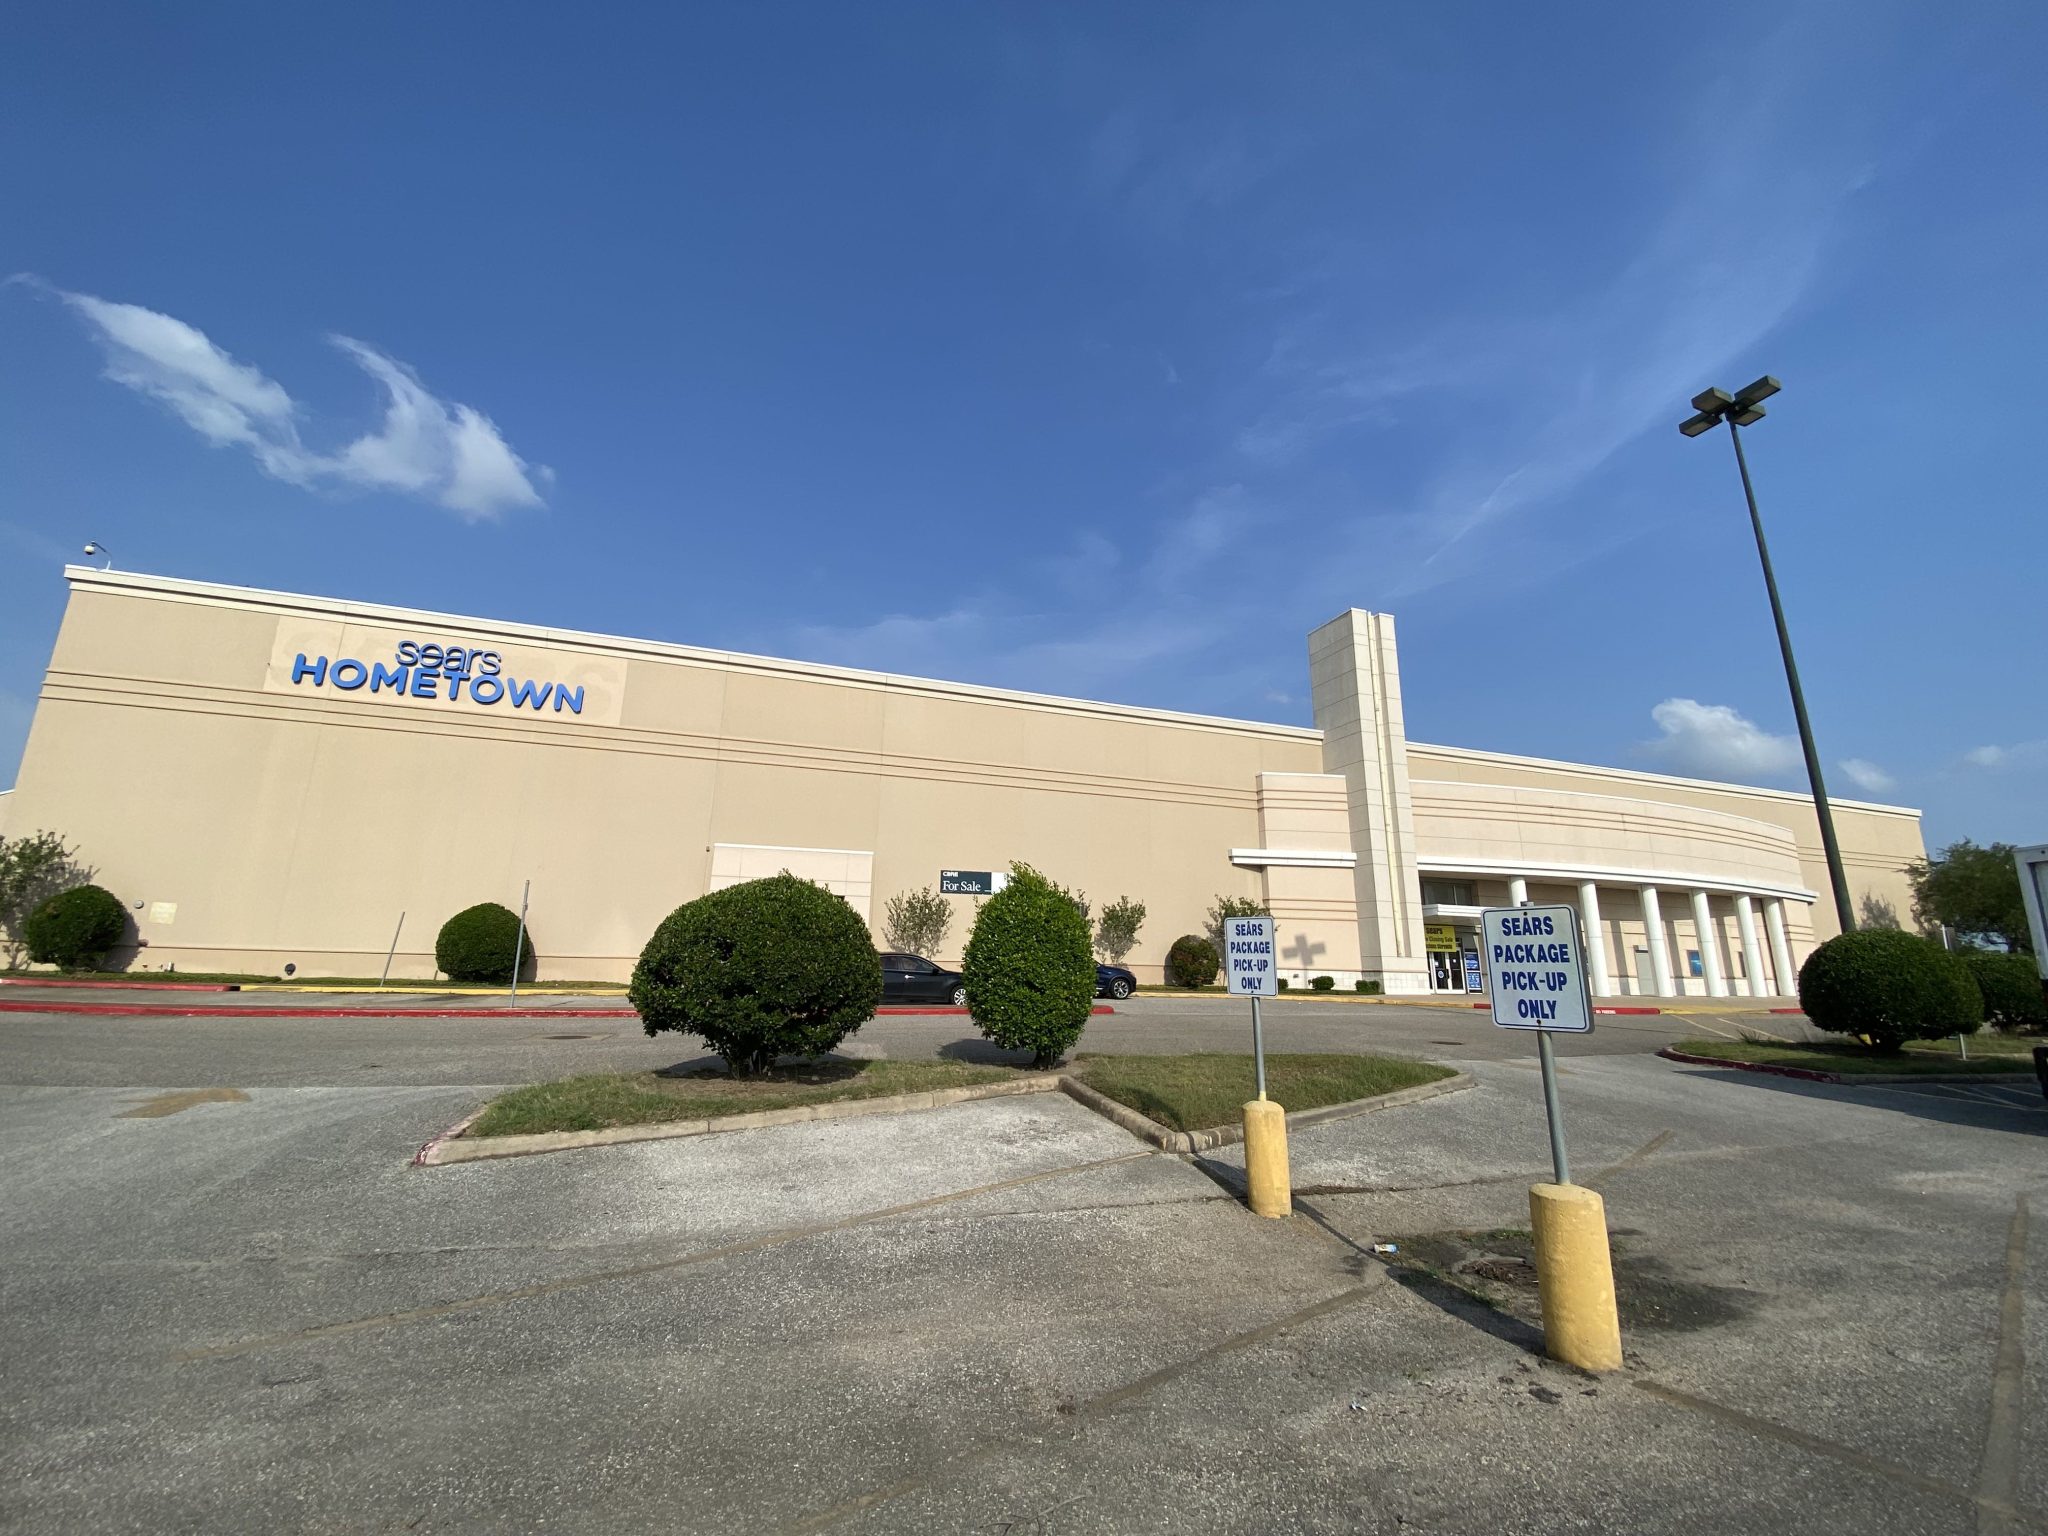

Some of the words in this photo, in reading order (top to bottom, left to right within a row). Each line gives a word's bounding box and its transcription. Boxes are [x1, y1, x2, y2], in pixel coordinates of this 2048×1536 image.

[291, 653, 585, 713] HOMETOWN
[943, 880, 959, 891] For
[960, 880, 981, 892] Sale
[1235, 923, 1263, 936] SEARS
[1501, 915, 1554, 937] SEARS
[1230, 941, 1270, 954] PACKAGE
[1493, 943, 1570, 963] PACKAGE
[1233, 958, 1268, 972] PICK-UP
[1241, 976, 1262, 990] ONLY
[1501, 971, 1568, 991] PICK-UP
[1517, 999, 1557, 1020] ONLY
